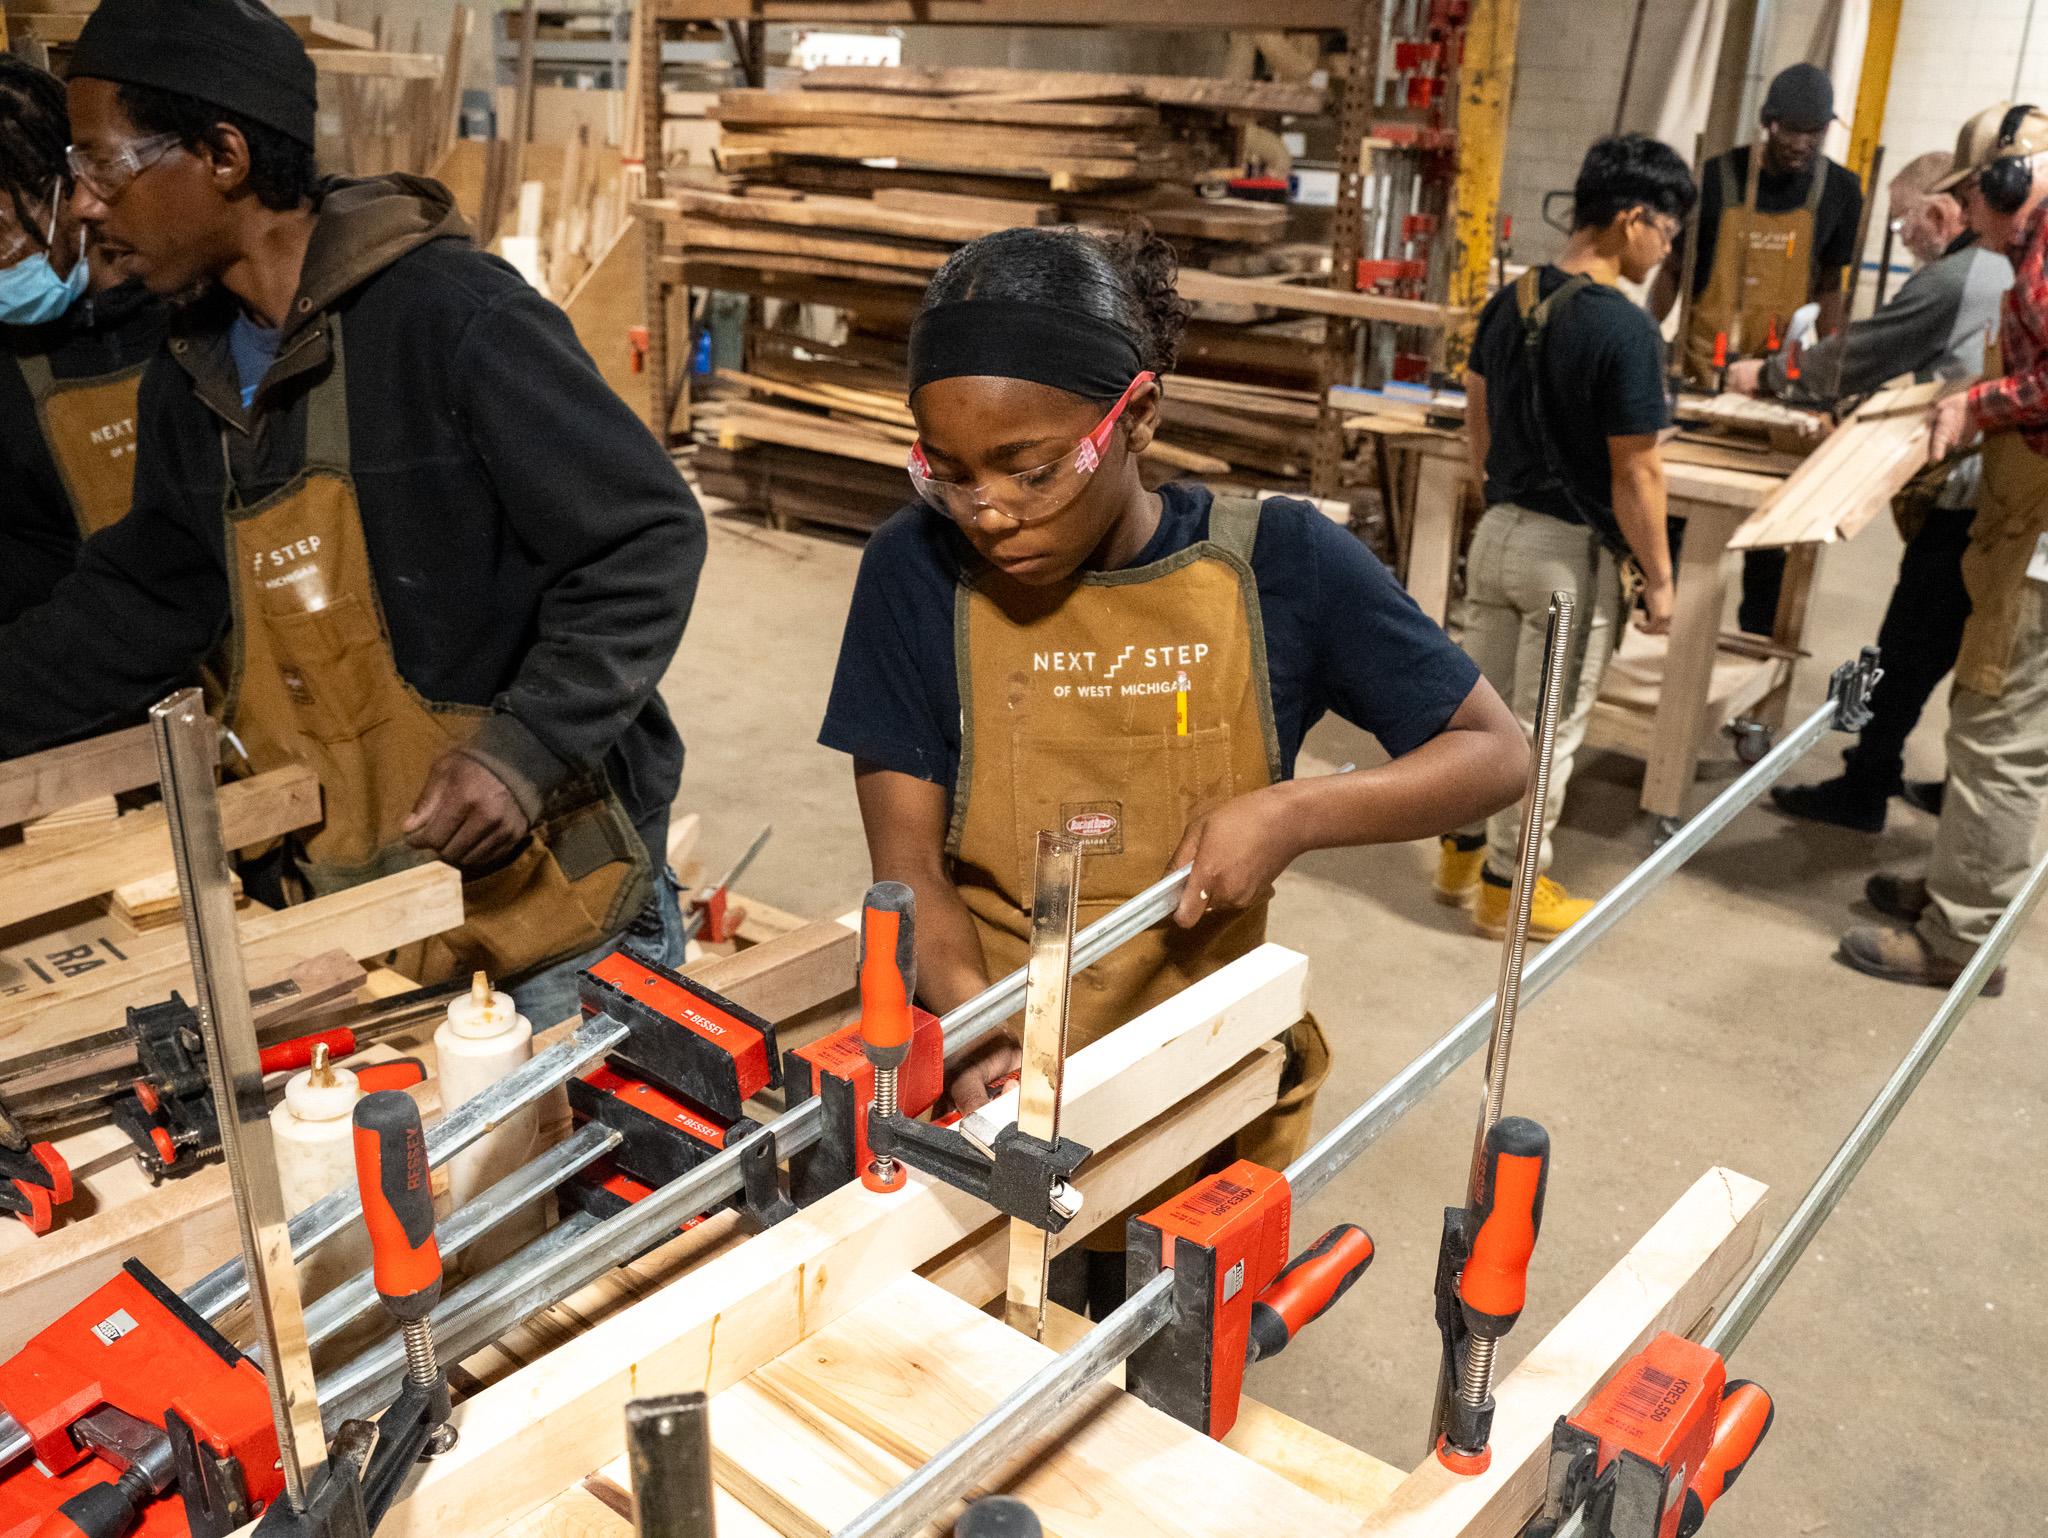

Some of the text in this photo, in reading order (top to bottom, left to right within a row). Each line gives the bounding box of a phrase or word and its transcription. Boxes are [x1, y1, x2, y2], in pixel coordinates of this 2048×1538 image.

[90, 418, 134, 445] NEXT
[270, 536, 320, 566] STEP
[1033, 643, 1208, 672] NEXT STEP
[1053, 685, 1071, 697] OF
[1077, 685, 1112, 697] WEST
[690, 1014, 727, 1036] BESSEY
[683, 1118, 719, 1137] BESSEY
[406, 1128, 420, 1191] BESSEY
[97, 1320, 120, 1341] BESSEY
[1650, 1378, 1690, 1423] KRE3.550
